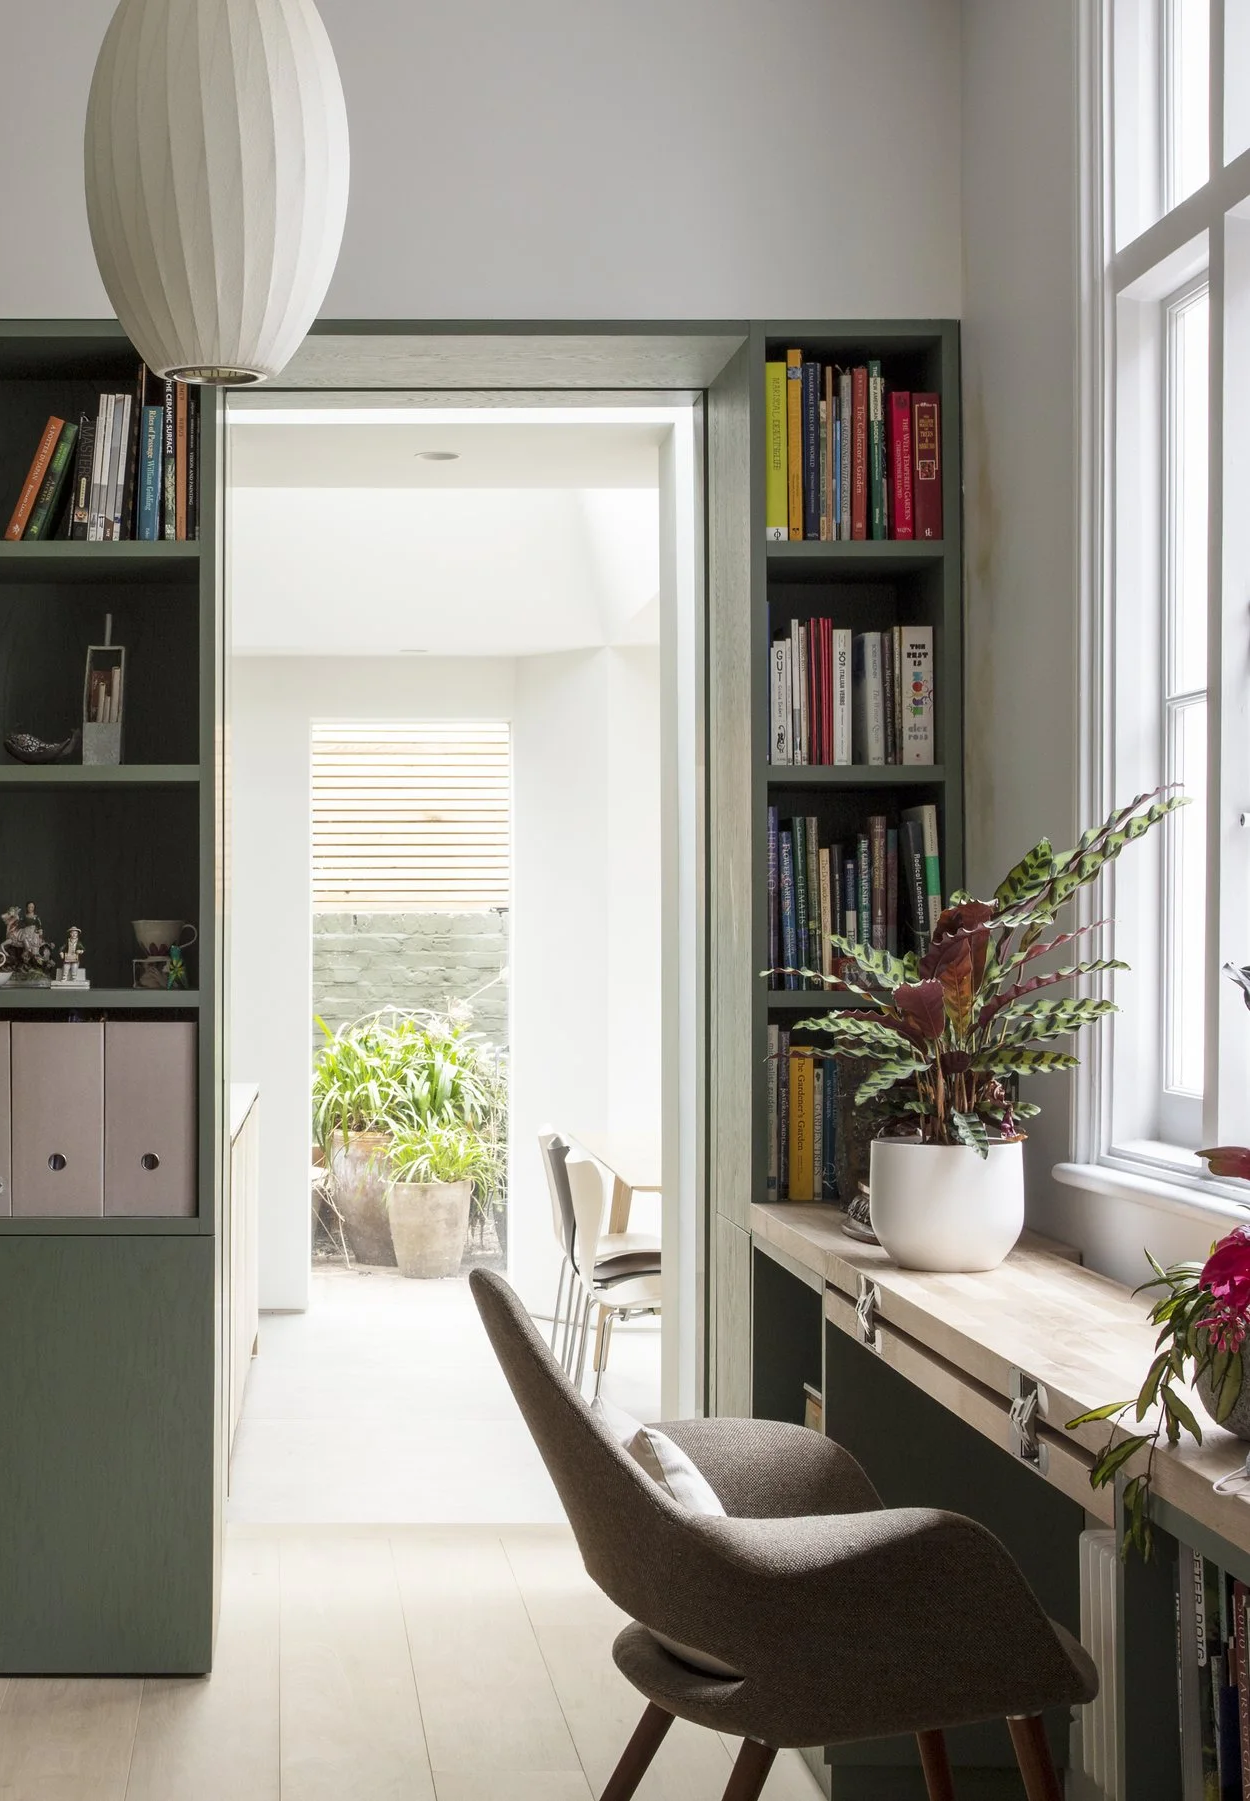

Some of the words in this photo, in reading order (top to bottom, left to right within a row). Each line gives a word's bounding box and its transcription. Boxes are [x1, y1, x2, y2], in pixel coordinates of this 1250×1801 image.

[42, 431, 54, 454] POTTER
[146, 434, 155, 459] Passage
[146, 460, 155, 486] William
[145, 486, 154, 510] Golding
[784, 878, 792, 916] GARDENS
[798, 875, 806, 924] CLEMATIS
[916, 882, 925, 924] Landscapes
[1239, 1658, 1247, 1718] YEARS
[1243, 1725, 1248, 1742] OF
